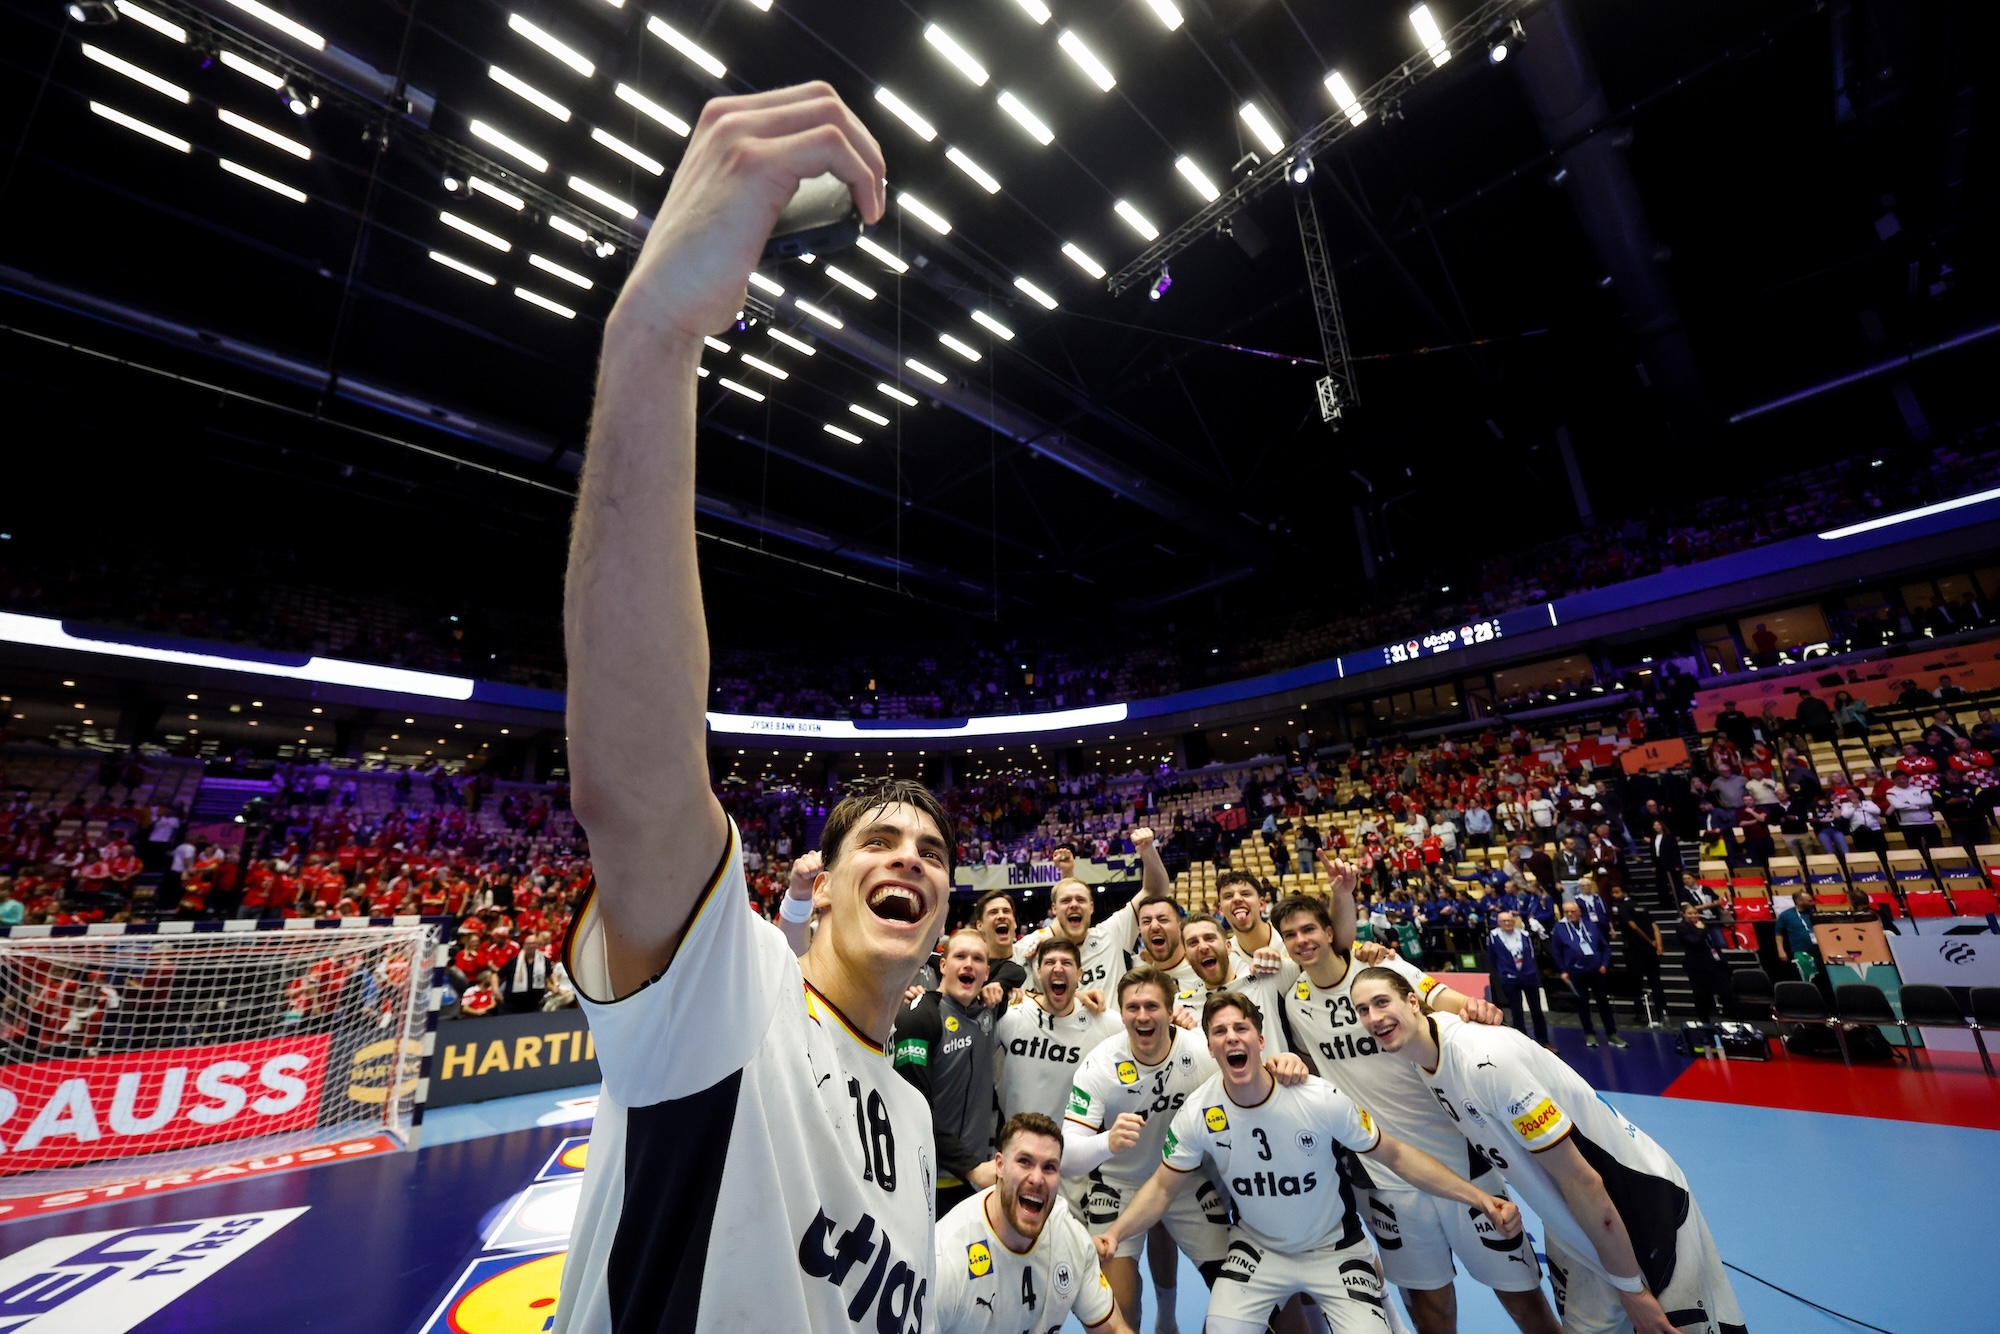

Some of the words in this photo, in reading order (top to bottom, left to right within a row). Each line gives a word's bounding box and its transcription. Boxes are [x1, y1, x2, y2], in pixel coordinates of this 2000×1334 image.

[1390, 644, 1408, 662] 31
[1423, 631, 1456, 648] 60:00
[1474, 622, 1494, 642] 28
[776, 722, 795, 731] BANK
[1326, 996, 1358, 1028] 23
[441, 1030, 596, 1080] HARTI
[896, 1045, 927, 1058] ALSCO
[943, 1035, 973, 1055] atlas
[1010, 1037, 1081, 1064] atlas
[1319, 1034, 1388, 1060] atla
[847, 1076, 897, 1193] 18
[1519, 1104, 1557, 1136] Josera
[1252, 1128, 1272, 1161] 3
[38, 1140, 376, 1208] STRAUSS
[1232, 1171, 1317, 1197] atlas
[129, 1217, 264, 1281] TYRES
[1021, 1266, 1037, 1311] 4
